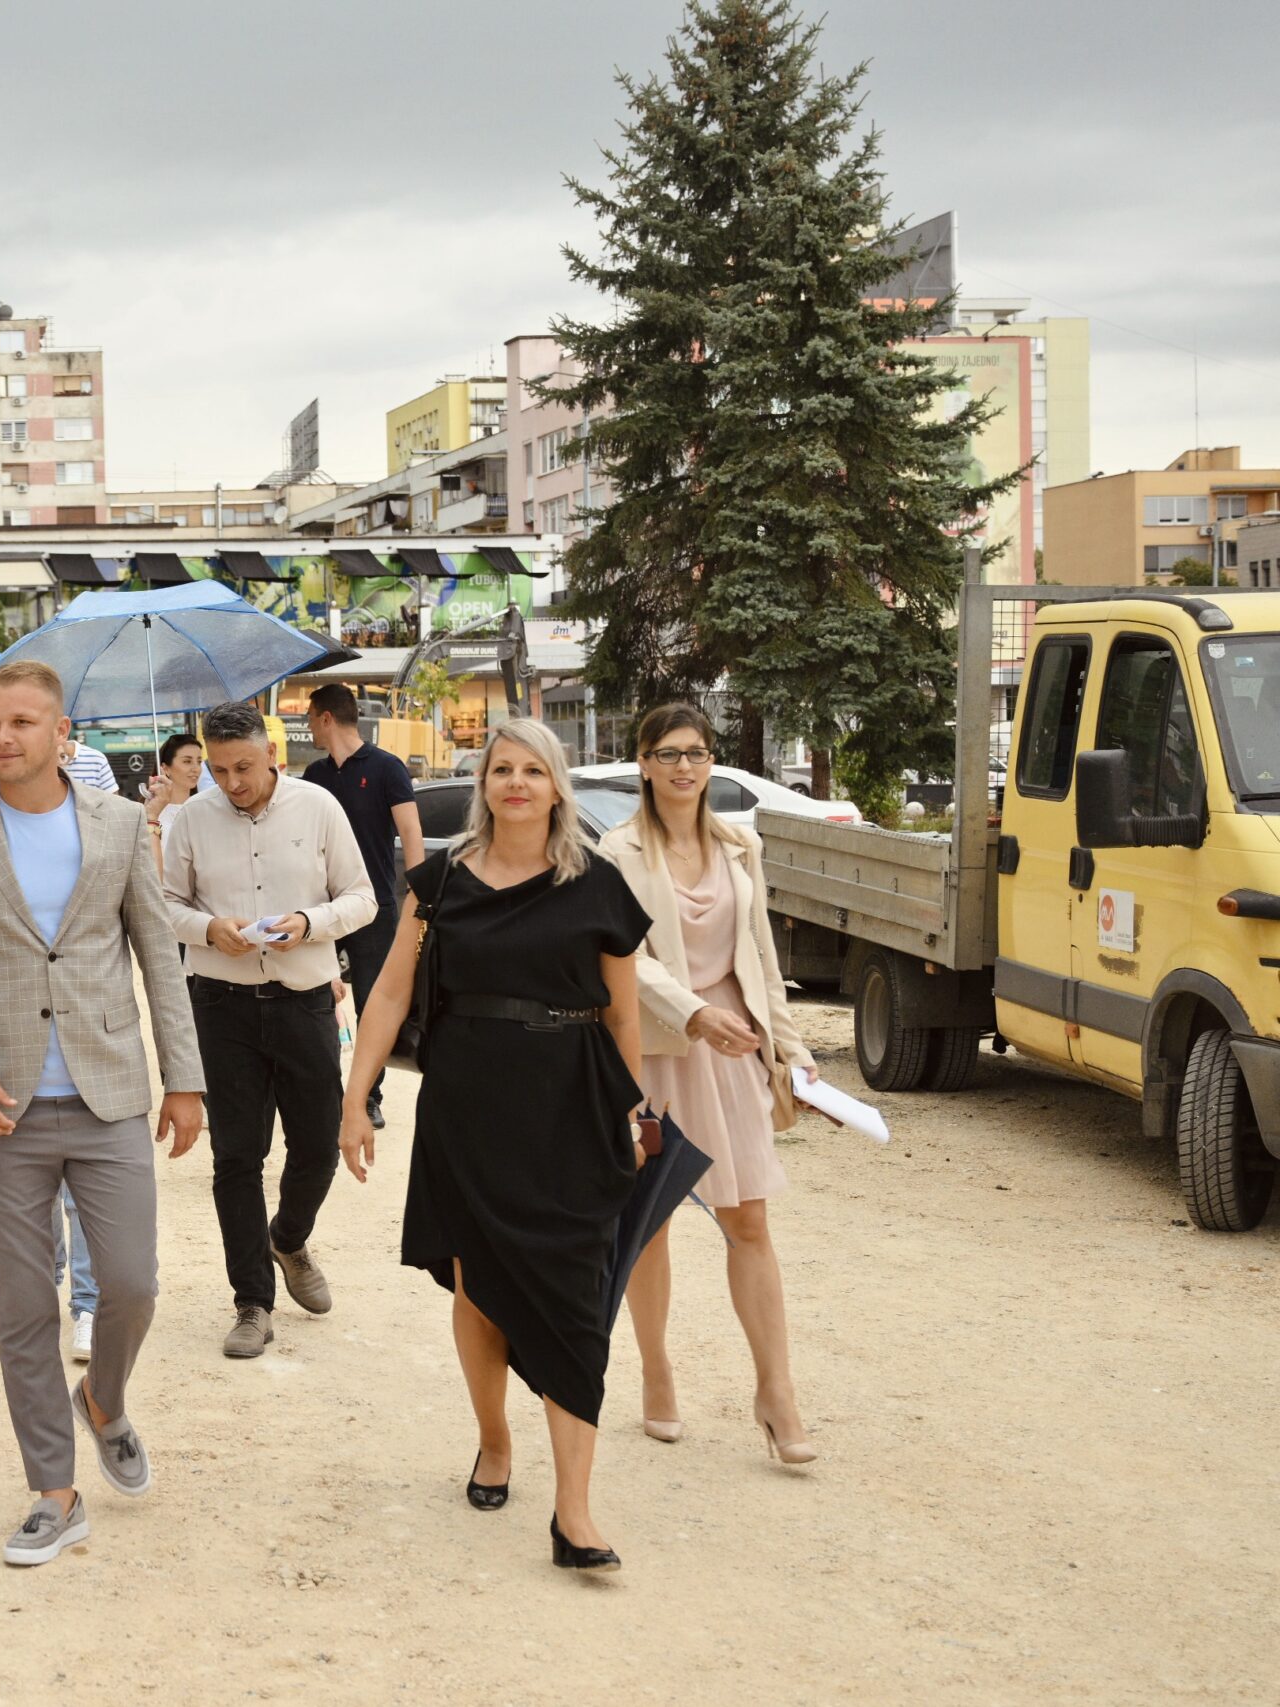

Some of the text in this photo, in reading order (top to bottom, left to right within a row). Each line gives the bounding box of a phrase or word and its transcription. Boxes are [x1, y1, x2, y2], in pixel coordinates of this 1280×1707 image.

[934, 355, 1000, 367] ODINA ZAJEDNO!
[448, 601, 494, 616] OPEN
[552, 625, 569, 636] dm
[284, 732, 314, 742] VOLV
